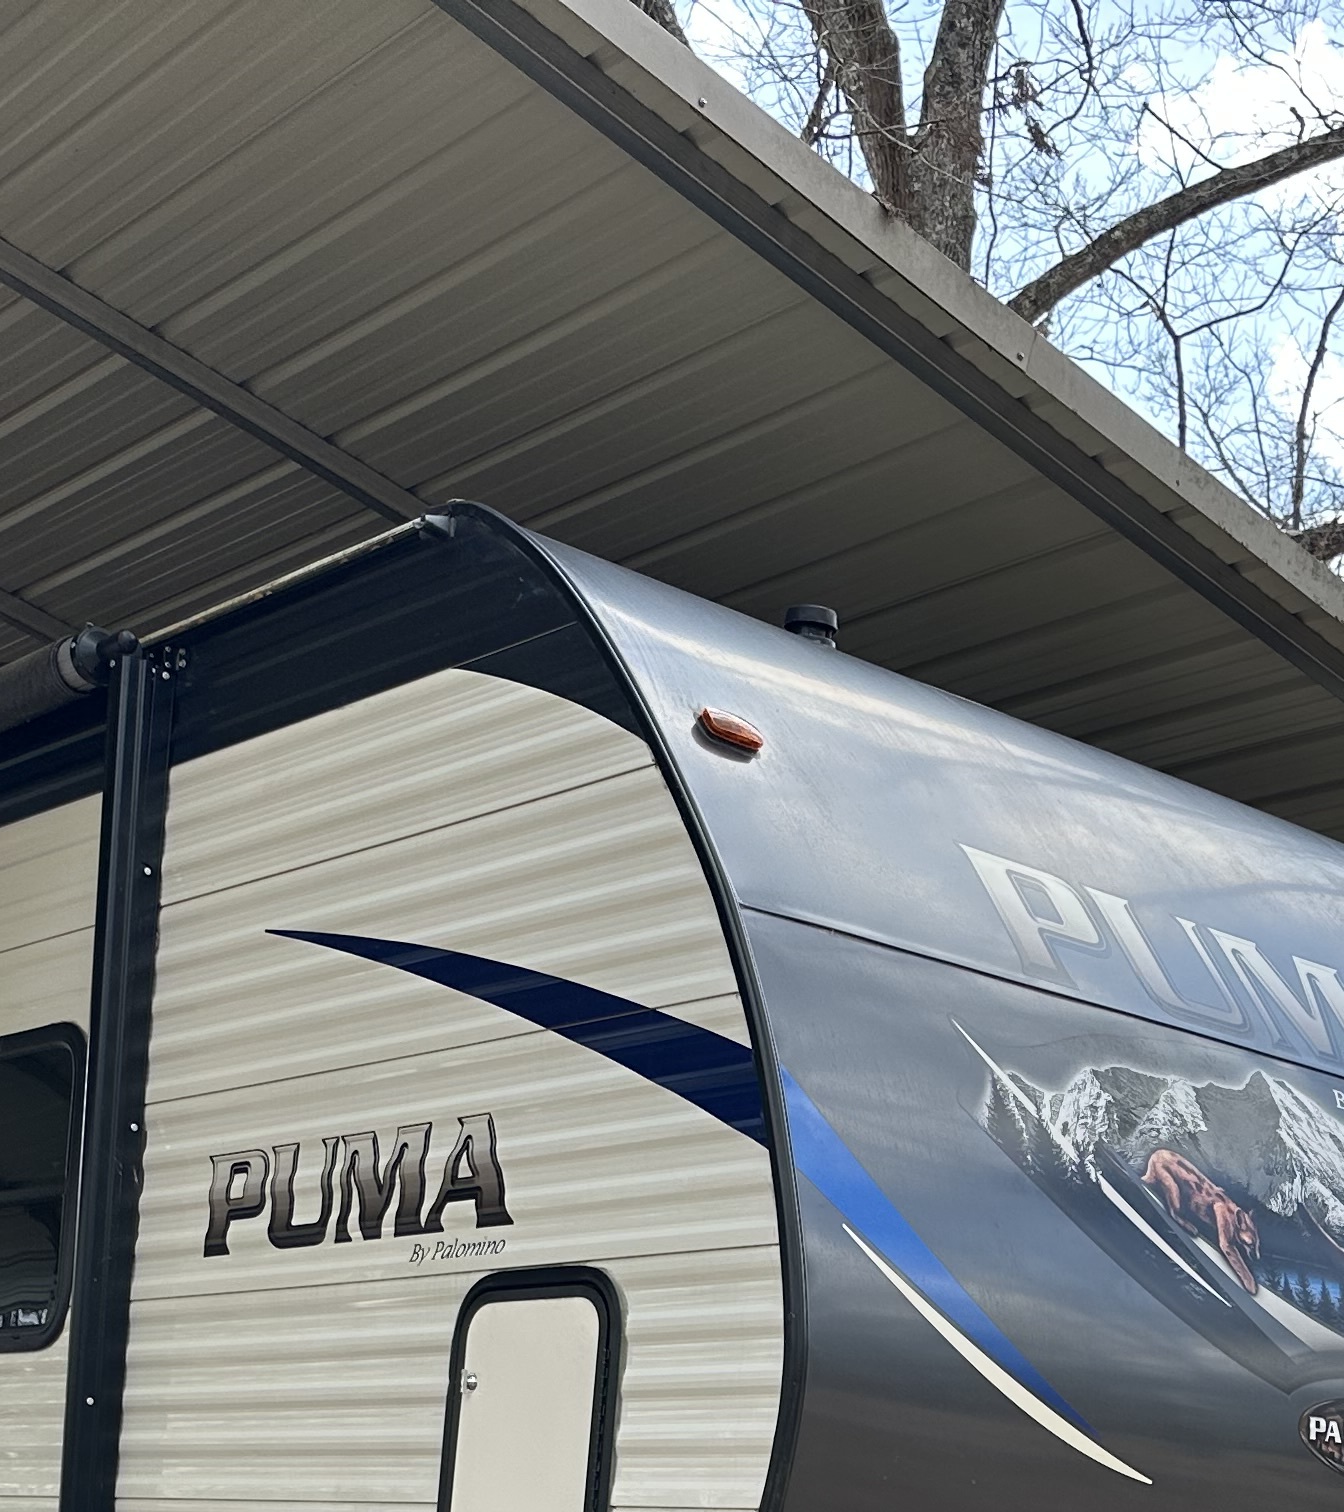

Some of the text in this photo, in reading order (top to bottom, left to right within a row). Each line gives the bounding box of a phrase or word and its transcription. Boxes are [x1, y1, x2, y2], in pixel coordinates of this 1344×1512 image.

[203, 1112, 515, 1258] PUMA
[409, 1237, 506, 1267] By Palomino
